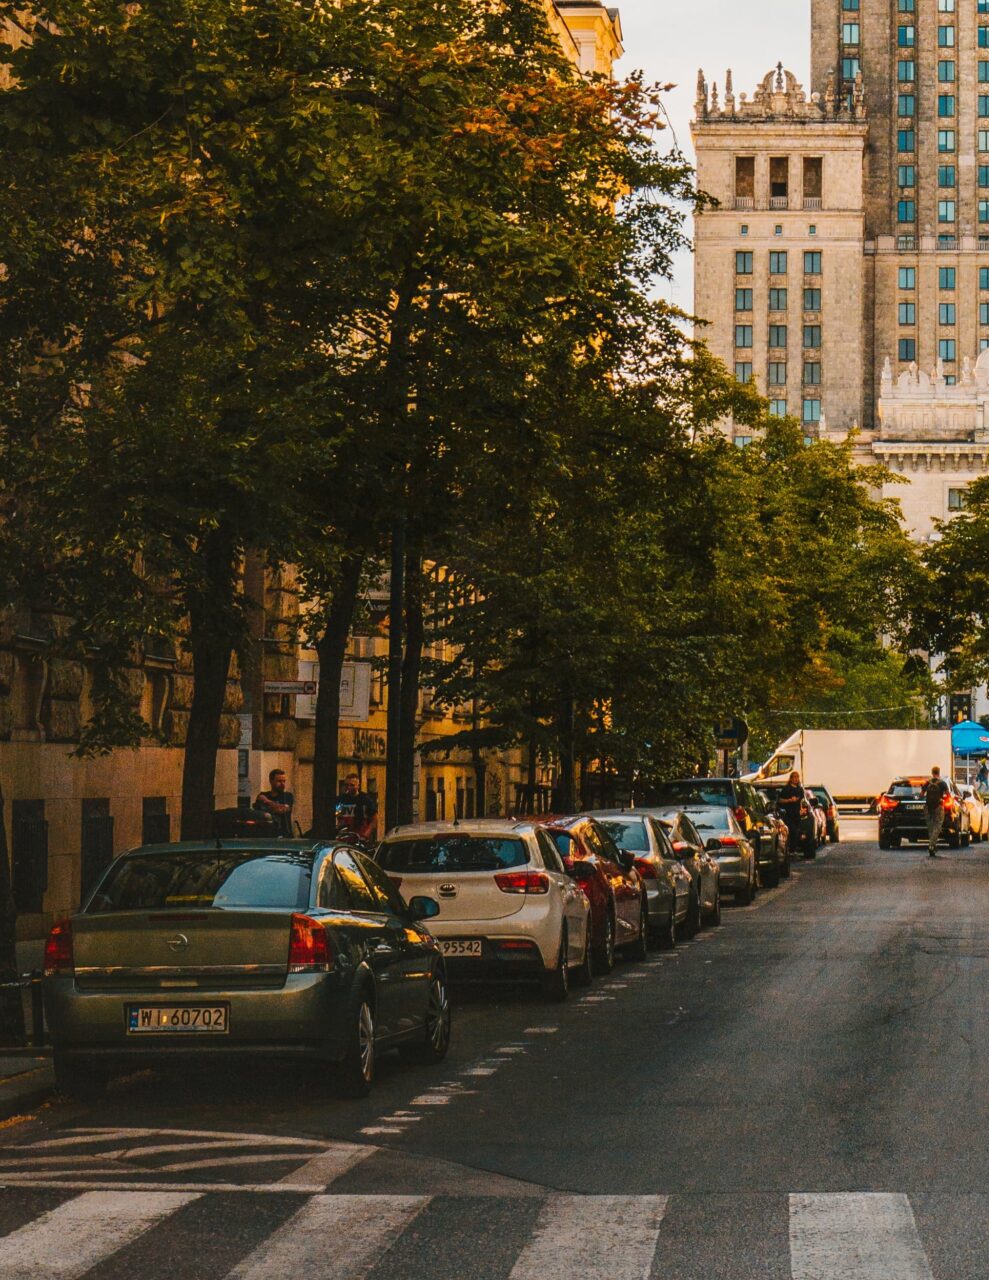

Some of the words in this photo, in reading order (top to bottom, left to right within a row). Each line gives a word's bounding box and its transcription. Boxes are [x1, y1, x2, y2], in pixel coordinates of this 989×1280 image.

[443, 941, 480, 954] 95542
[141, 1009, 160, 1026] WI
[170, 1009, 222, 1026] 60702
